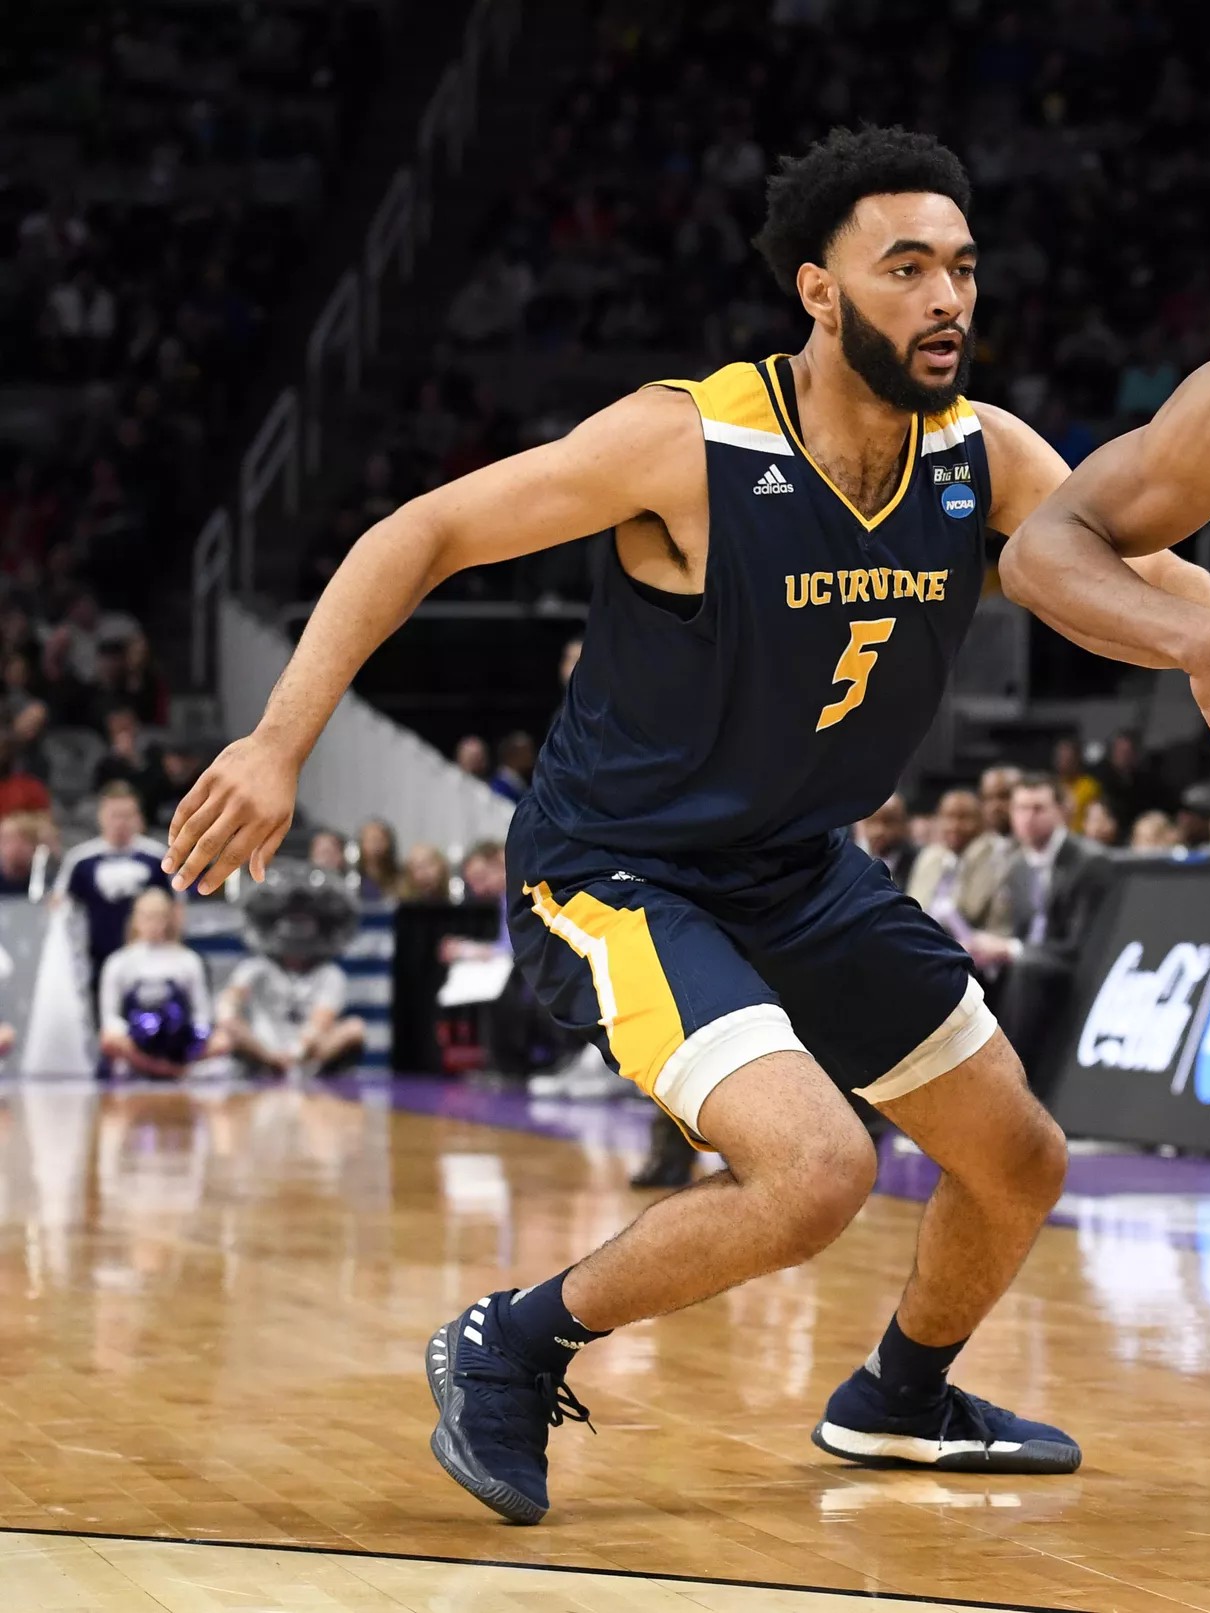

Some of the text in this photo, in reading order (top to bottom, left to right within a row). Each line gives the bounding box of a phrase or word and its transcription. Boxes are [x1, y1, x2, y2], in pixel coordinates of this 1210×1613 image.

[753, 481, 794, 495] adidas
[946, 499, 974, 511] NCAA
[785, 567, 949, 609] UC IRVINE
[815, 617, 896, 733] 5
